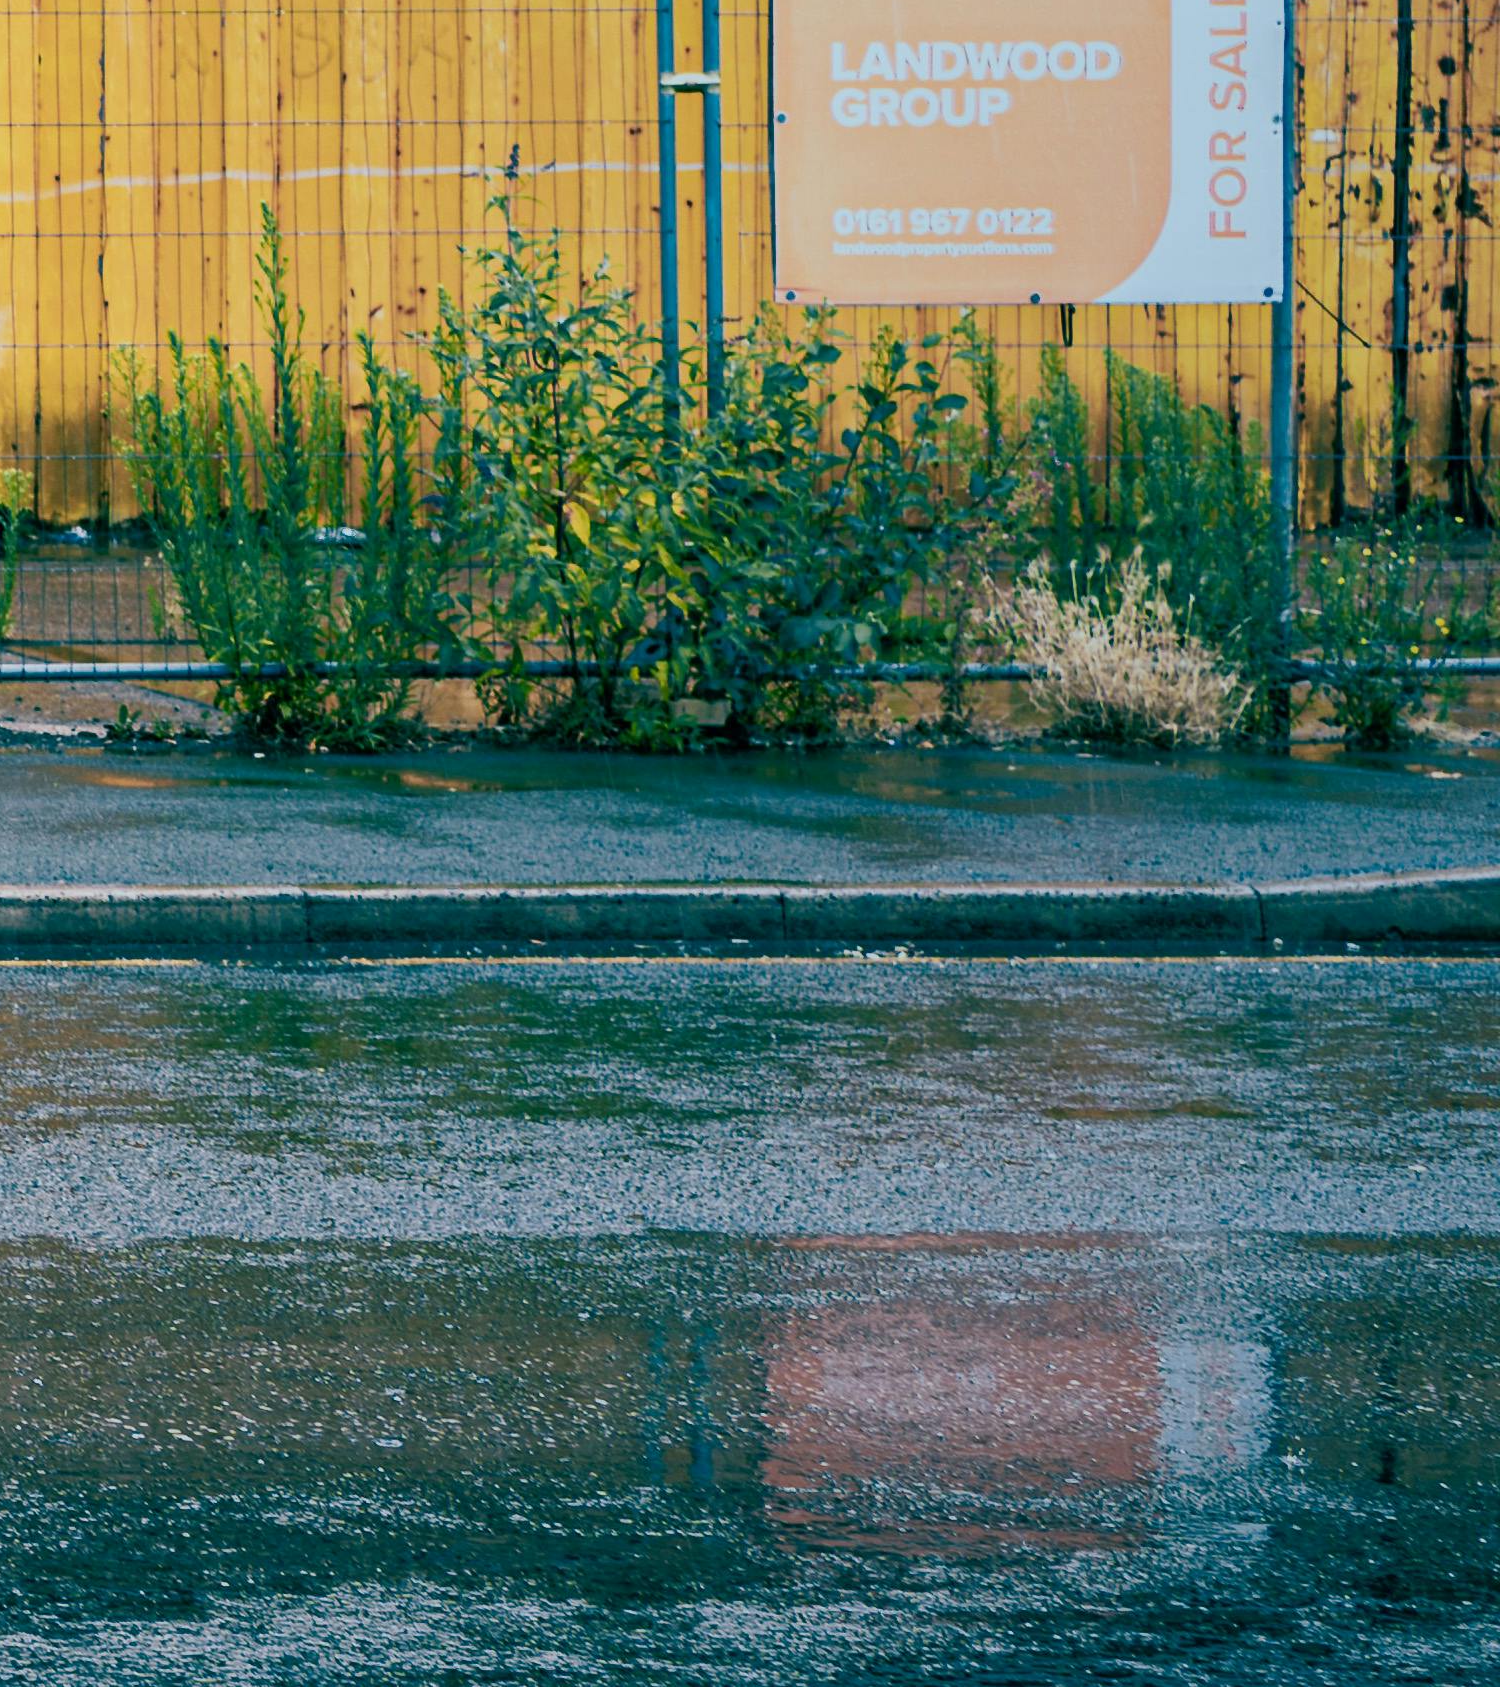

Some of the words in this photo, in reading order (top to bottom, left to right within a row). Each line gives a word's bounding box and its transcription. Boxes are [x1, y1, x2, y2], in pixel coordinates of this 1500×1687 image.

[831, 41, 1122, 81] LANDWOOD
[831, 87, 1011, 128] GROUP
[1208, 131, 1247, 239] FOR
[833, 208, 905, 236] 0161
[908, 208, 972, 236] 967
[976, 208, 1054, 235] 0122
